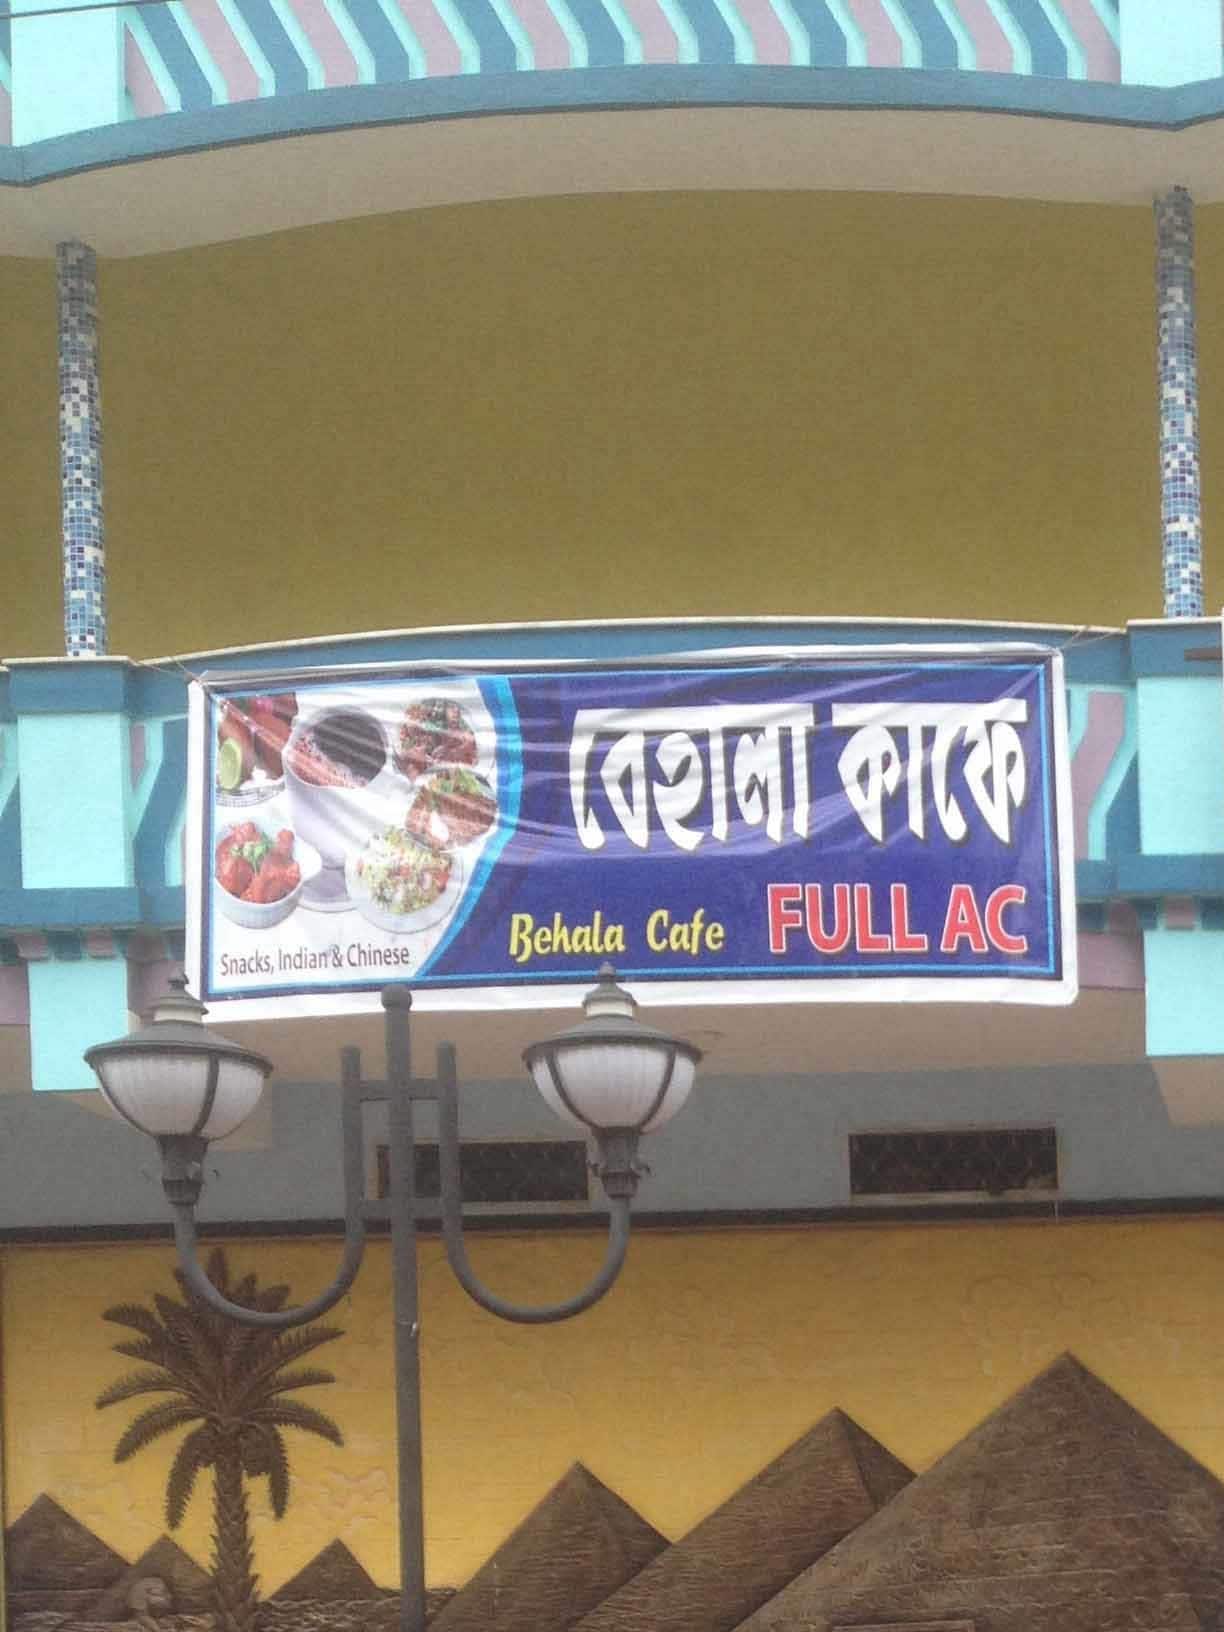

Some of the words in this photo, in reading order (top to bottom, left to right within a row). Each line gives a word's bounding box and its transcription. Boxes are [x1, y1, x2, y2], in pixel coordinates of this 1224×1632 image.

[569, 703, 815, 851] বেহালা
[832, 698, 1028, 842] কাফে
[219, 946, 275, 976] Snacks,
[278, 945, 329, 972] Indian
[332, 945, 344, 968] &
[347, 942, 410, 968] Chinese
[509, 909, 627, 962] Behala
[646, 907, 725, 957] Cafe
[767, 883, 928, 954] FULL
[940, 883, 1028, 953] AC
